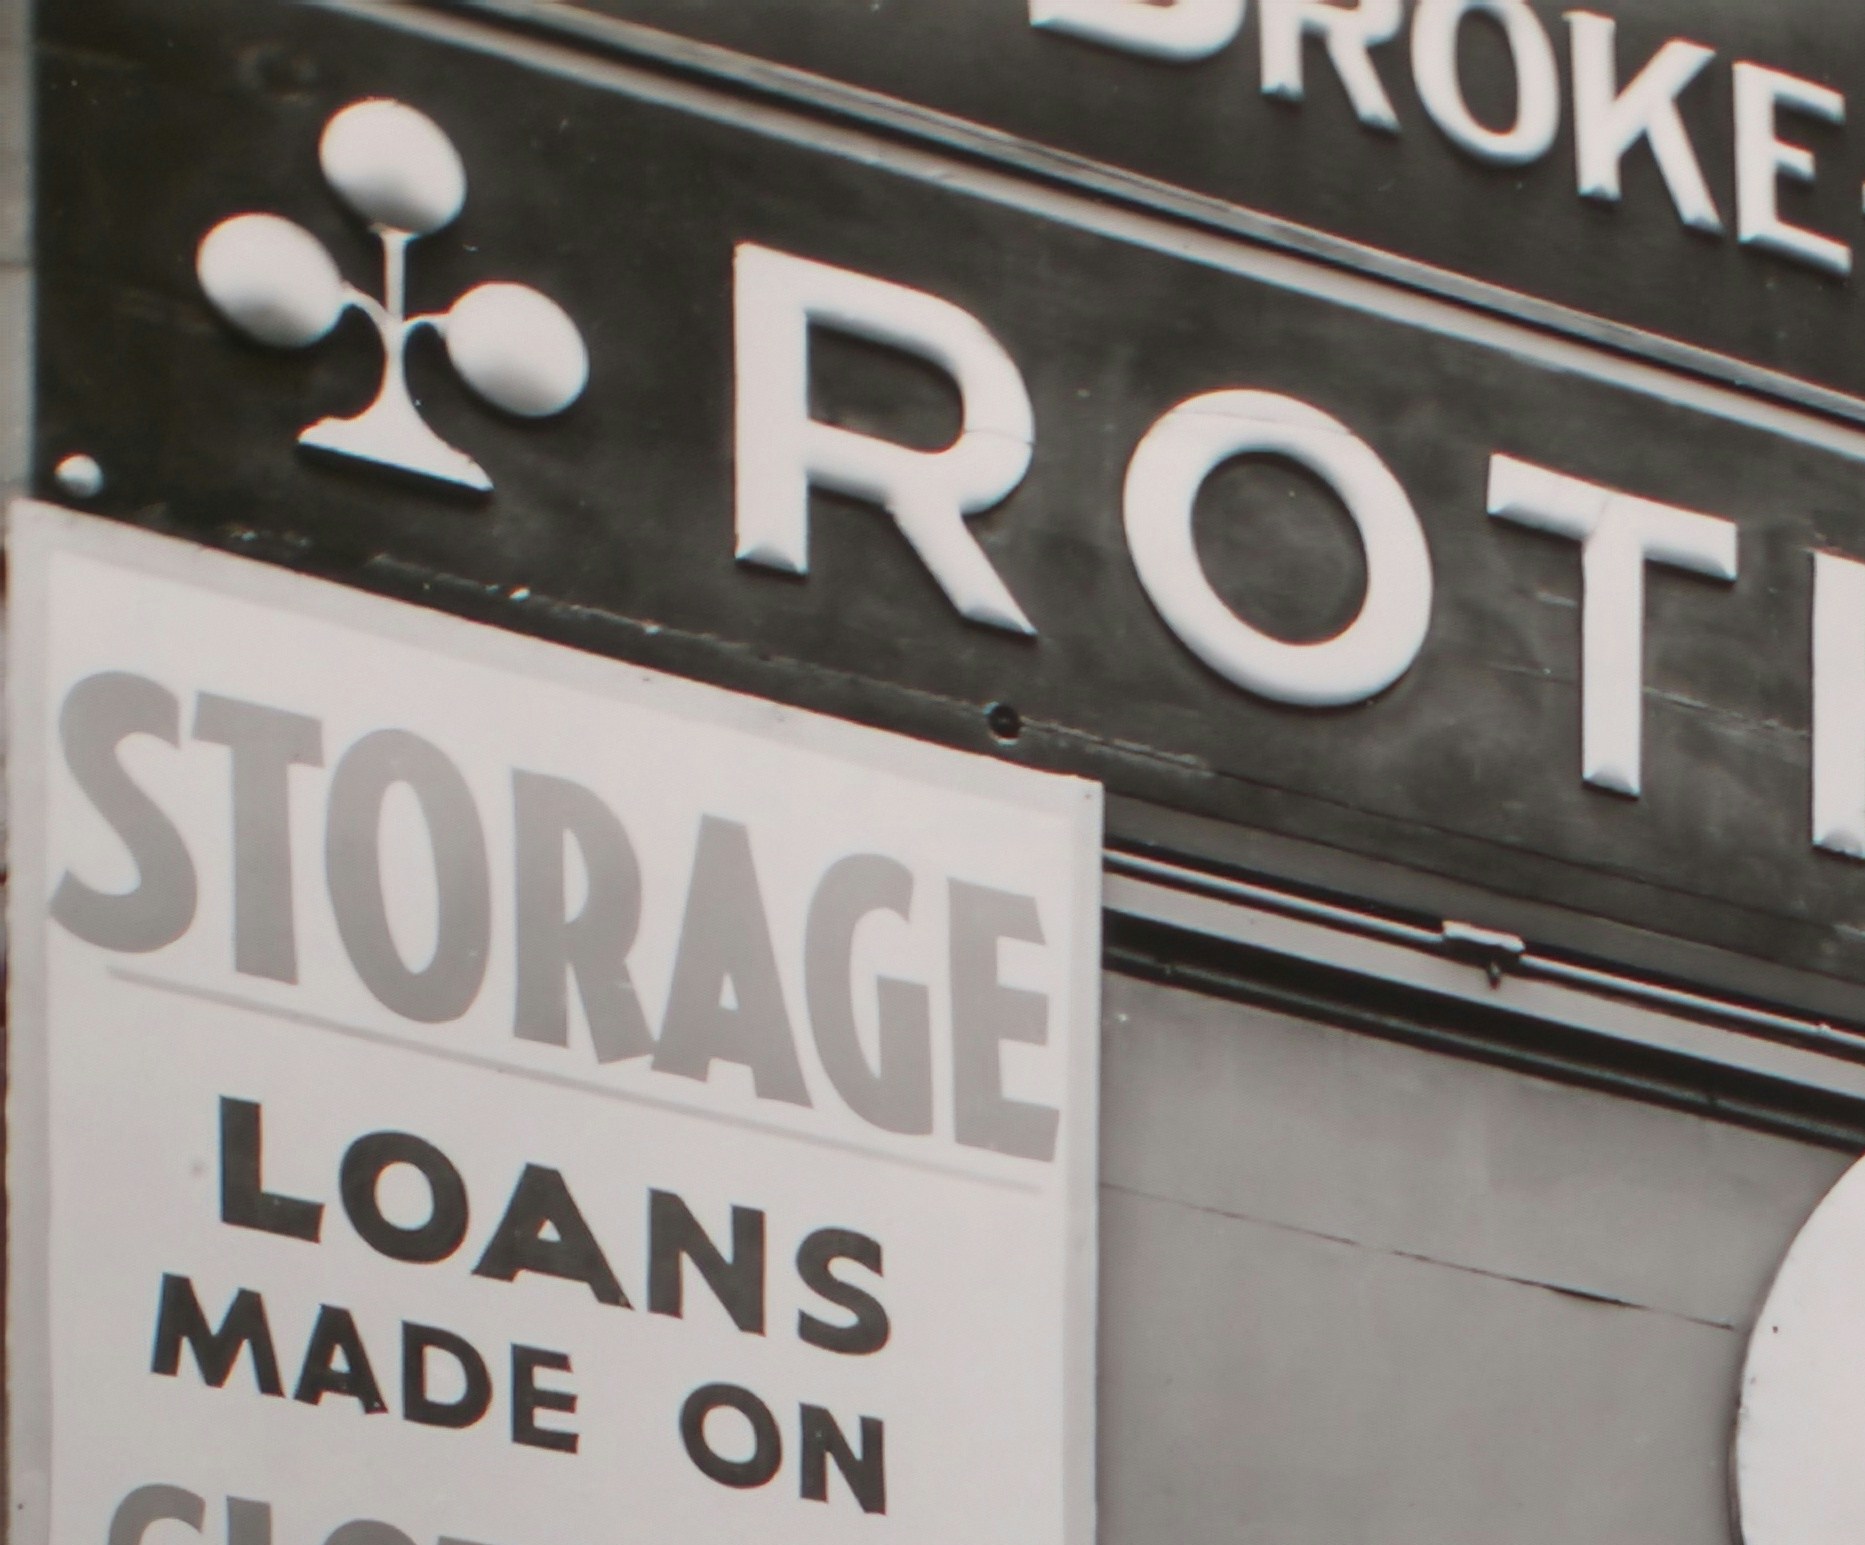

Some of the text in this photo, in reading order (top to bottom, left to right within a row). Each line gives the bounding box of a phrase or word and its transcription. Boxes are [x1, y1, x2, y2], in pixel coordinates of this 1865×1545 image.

[49, 671, 1061, 1163] STORAGE
[220, 1097, 890, 1355] LOANS
[152, 1274, 886, 1514] MADE ON
